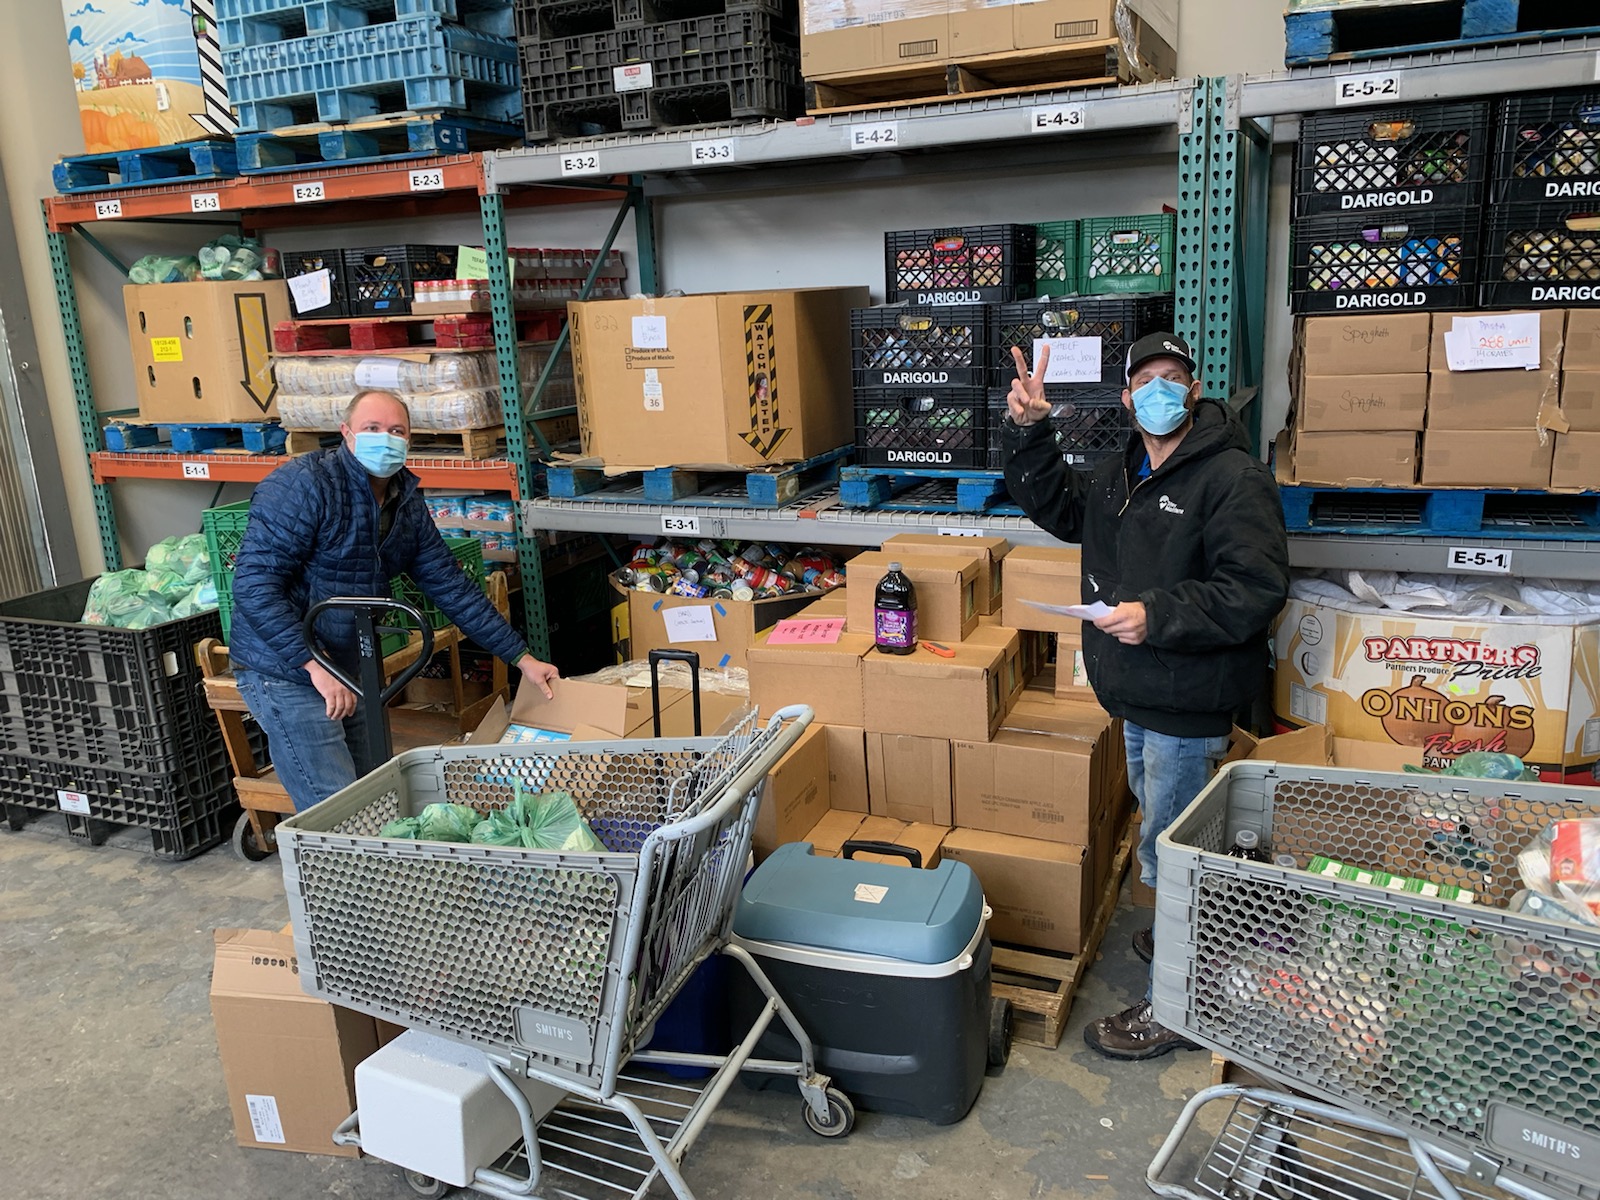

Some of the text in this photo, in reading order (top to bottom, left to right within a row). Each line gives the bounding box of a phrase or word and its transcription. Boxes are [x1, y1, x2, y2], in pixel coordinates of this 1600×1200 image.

[1342, 79, 1395, 98] E-5-2
[1036, 111, 1080, 127] E-4-3
[855, 128, 894, 145] E-4-2
[695, 146, 730, 160] E-3-3
[564, 157, 596, 171] E-3-2
[413, 174, 440, 187] E-2-3
[296, 186, 322, 199] E-2-2
[1341, 189, 1434, 210] DARIGOLD
[98, 203, 120, 215] E-1-2
[194, 197, 217, 209] E-1-3
[917, 290, 982, 304] DARIGOLD
[1335, 292, 1427, 309] DARIGOLD
[755, 324, 766, 369] WATCH
[1480, 335, 1504, 348] 288
[883, 371, 949, 384] DARIGOLD
[649, 398, 660, 408] 36
[760, 399, 770, 434] STEP
[887, 450, 952, 464] DARIGOLD
[185, 466, 206, 476] E-1-1
[664, 519, 694, 530] E-3-1
[1453, 550, 1503, 567] E-5-1
[1365, 637, 1539, 668] PARTNERS
[1385, 662, 1450, 675] Partners Produce
[1449, 660, 1543, 683] Pride
[1361, 688, 1535, 730] ONIONS
[1423, 730, 1508, 755] Fresh
[535, 1022, 573, 1041] SMITH'S
[1522, 1128, 1581, 1159] SMITH'S
